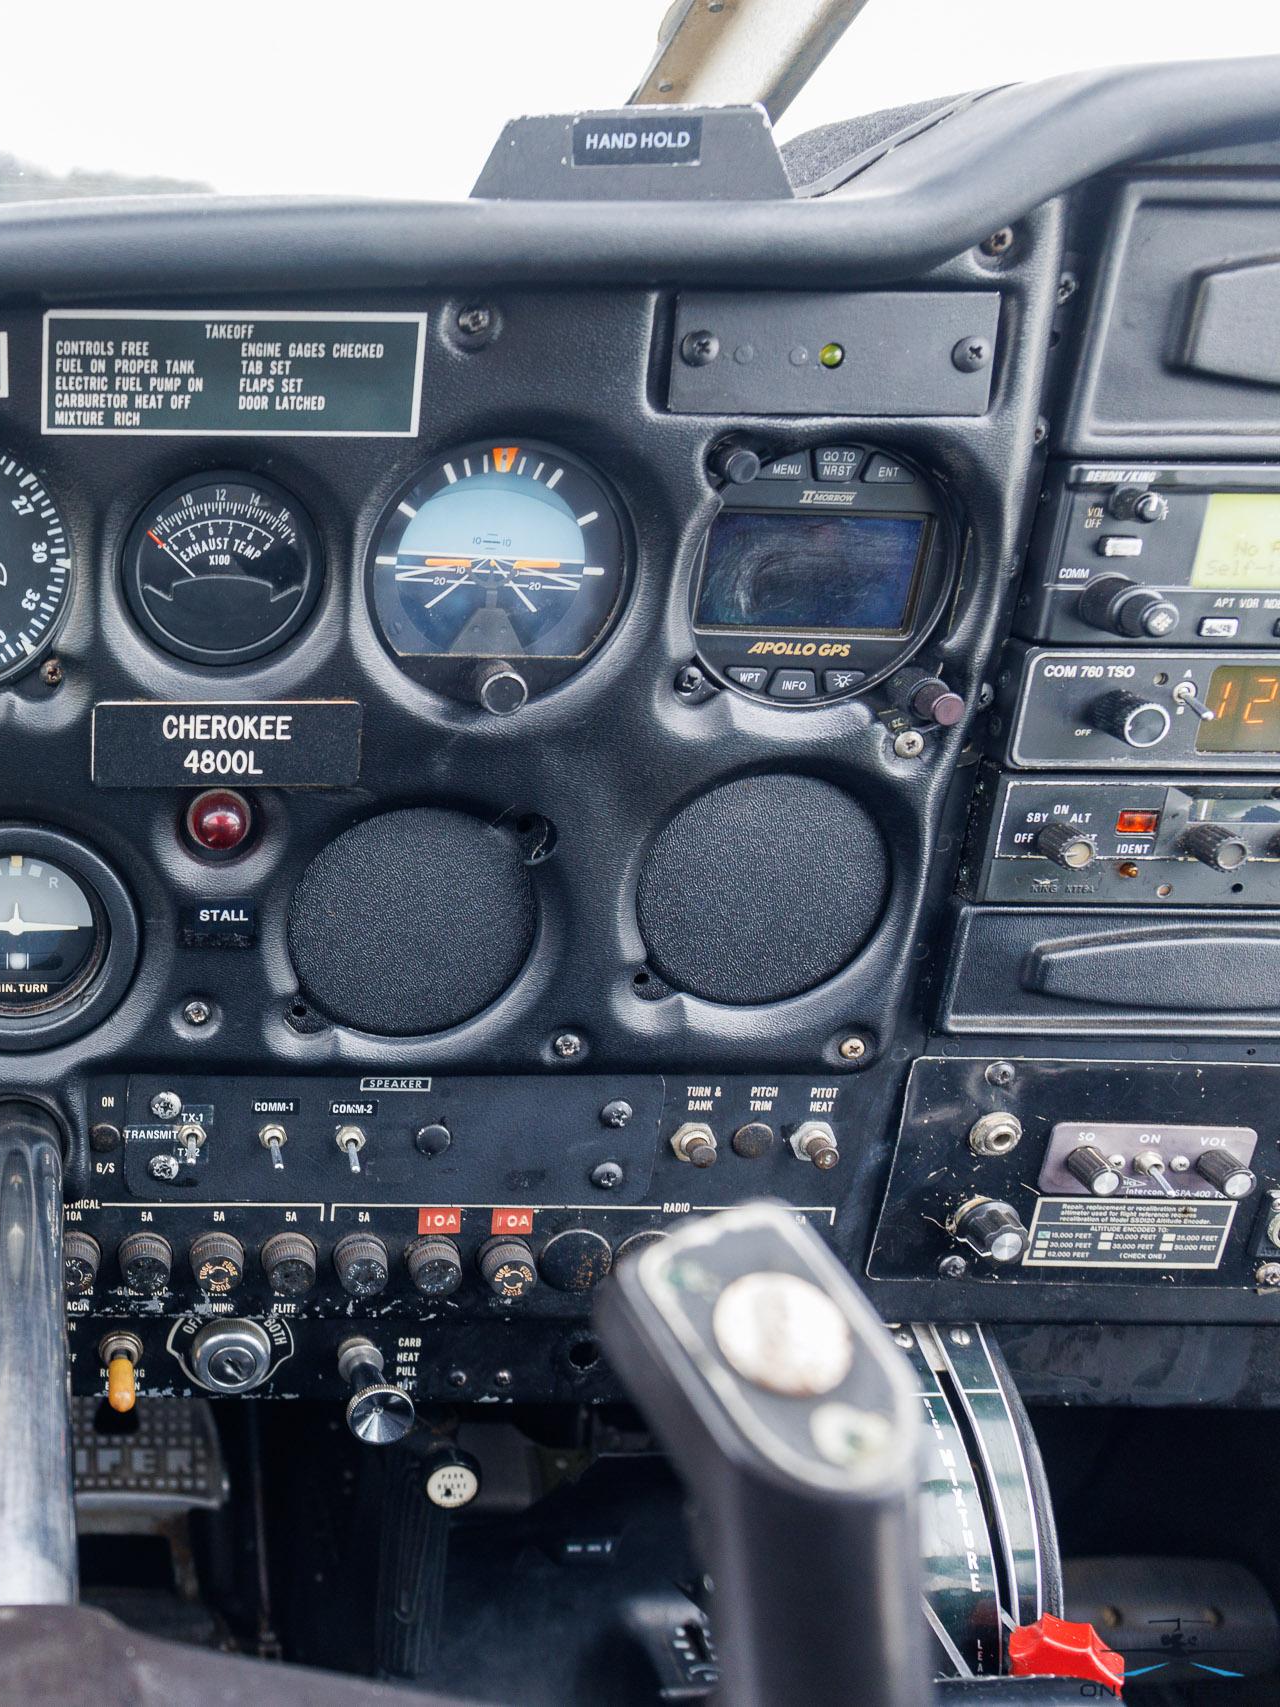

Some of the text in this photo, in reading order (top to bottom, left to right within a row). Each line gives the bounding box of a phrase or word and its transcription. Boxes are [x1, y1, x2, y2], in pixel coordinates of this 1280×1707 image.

[585, 131, 691, 150] HAND HOLD
[205, 324, 255, 340] TAKEOFF
[55, 340, 150, 356] CONTROLS FREE
[240, 342, 384, 359] ENGINE GAGES CHECKED
[55, 358, 195, 375] FUEL ON PROPER TANK
[240, 360, 292, 376] TAB SET
[55, 376, 204, 392] ELECTRIC FUEL PUMP ON
[239, 378, 304, 393] FLAPS SET
[54, 393, 192, 410] CARBURETOR HEAT OFF
[238, 395, 326, 411] DOOR LATCHED
[54, 411, 141, 426] MIXTURE RICH
[823, 451, 856, 462] GO TO
[772, 463, 802, 475] MENU
[822, 466, 852, 476] NRST
[878, 466, 899, 478] ENT
[1087, 507, 1104, 518] VOL
[1084, 519, 1103, 528] OFF
[179, 537, 262, 563] EXHAUST TEMP
[209, 555, 231, 566] X100
[1059, 568, 1090, 579] COMM
[1214, 598, 1259, 608] APT VOR
[748, 641, 851, 657] APOLLO GPS
[1044, 665, 1136, 678] COM 760 TSO
[739, 672, 760, 683] WPT
[781, 680, 807, 691] INFO
[162, 714, 293, 740] CHEROKEE
[183, 750, 263, 775] 4800L
[1053, 804, 1070, 815] ON
[1026, 812, 1092, 823] SBY ALT
[1014, 833, 1034, 843] OFF
[1116, 844, 1150, 854] IDENT
[199, 909, 249, 922] STALL
[19, 983, 48, 993] TURN
[369, 1079, 422, 1089] SPEAKER
[687, 1086, 722, 1097] TURN &
[750, 1086, 779, 1098] PITCH
[810, 1087, 839, 1099] PITOT
[101, 1096, 115, 1108] ON
[254, 1101, 294, 1112] COMM-1
[687, 1100, 713, 1111] BANK
[749, 1100, 773, 1111] TRIM
[809, 1101, 834, 1112] HEAT
[332, 1104, 373, 1114] COMM-2
[181, 1113, 204, 1122] TX-1
[124, 1130, 179, 1139] TRANSMIT
[1139, 1134, 1162, 1144] ON
[1200, 1137, 1227, 1147] VOL
[96, 1162, 115, 1175] G/S
[663, 1202, 691, 1214] RADIO
[358, 1212, 370, 1223] 5A
[427, 1214, 457, 1227] 10A
[263, 1318, 288, 1346] BOTH
[398, 1337, 422, 1347] CARB
[396, 1352, 420, 1362] HEAT
[395, 1366, 417, 1376] PULL
[938, 1448, 982, 1593] MIXTURE
